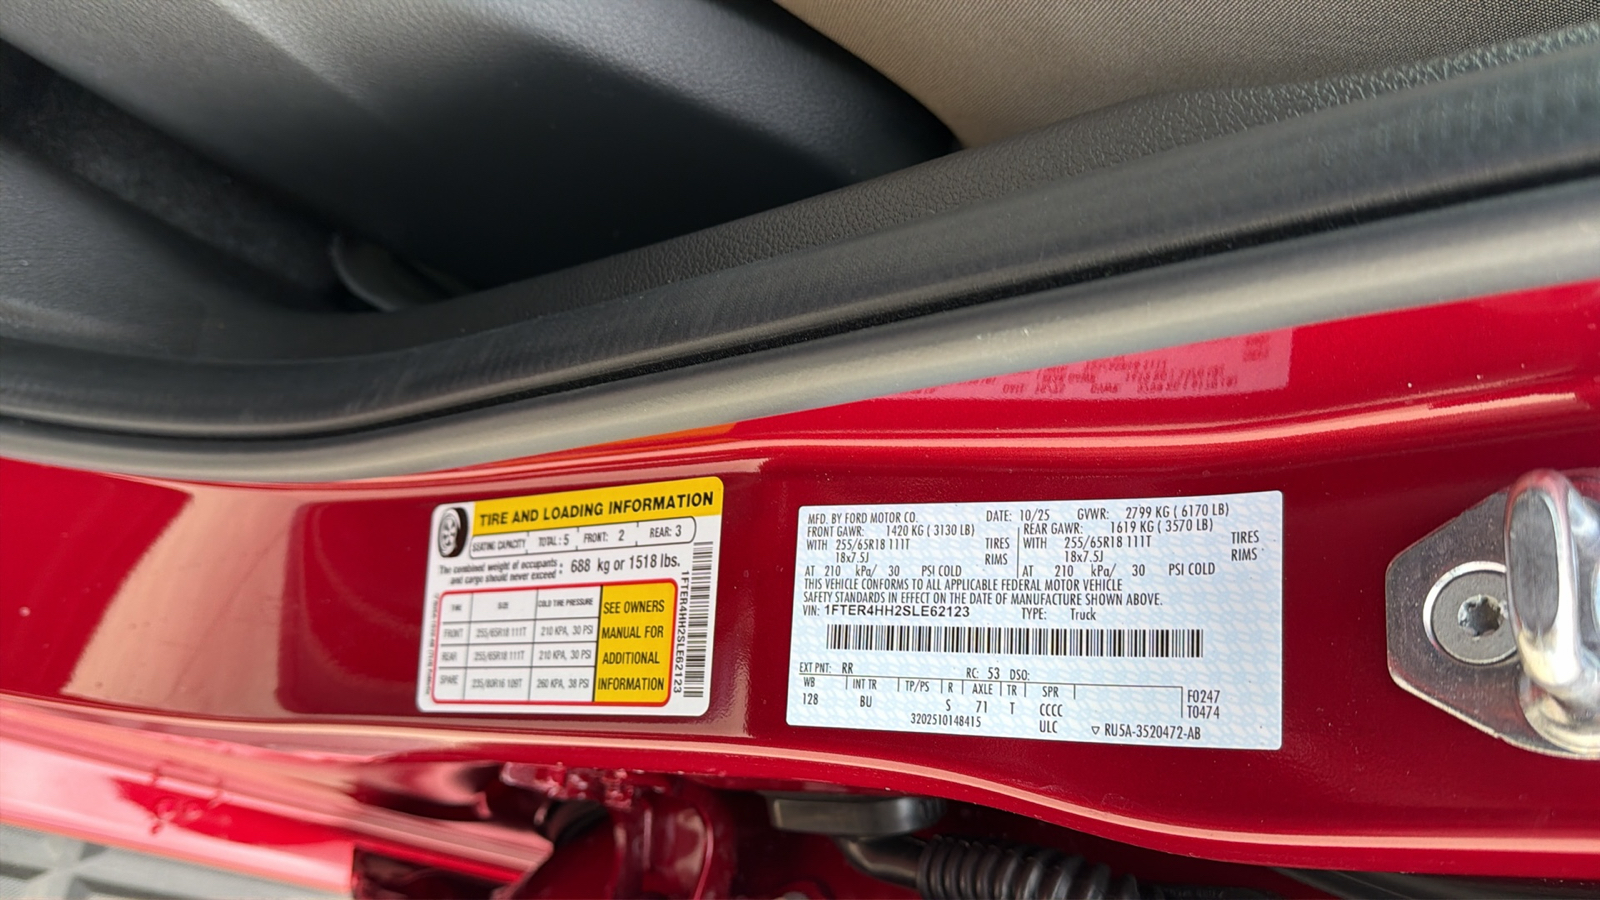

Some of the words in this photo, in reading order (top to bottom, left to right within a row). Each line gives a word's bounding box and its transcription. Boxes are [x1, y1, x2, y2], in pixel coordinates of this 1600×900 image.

[480, 512, 509, 526] TIRE
[512, 509, 538, 524] AND
[544, 502, 603, 520] LOADING
[609, 492, 714, 514] INFORMATION
[986, 510, 1012, 522] DATE:
[1020, 508, 1050, 522] 10/25
[1077, 508, 1109, 520] GVWR:
[1126, 506, 1152, 520] 2799
[1156, 506, 1170, 518] KG
[1182, 504, 1208, 518] 6170
[1212, 502, 1229, 518] LB)
[808, 513, 828, 524] MFD.
[831, 513, 842, 524] BY
[844, 512, 868, 524] FORD
[870, 512, 901, 524] MOTOR
[904, 511, 918, 523] CO.
[650, 526, 672, 538] REAR:
[675, 524, 682, 536] 3
[806, 526, 834, 537] FRONT
[836, 526, 864, 537] GAWR:
[886, 524, 908, 536] 1420
[912, 524, 924, 536] KG
[934, 524, 958, 536] 3130
[960, 524, 975, 537] LB)
[1024, 523, 1048, 534] REAR
[1051, 522, 1083, 534] GAWR:
[1111, 521, 1136, 534] 1619
[1140, 520, 1154, 533] KG
[1166, 519, 1192, 532] 3570
[1196, 518, 1214, 532] LB)
[564, 534, 570, 546] 5
[584, 532, 608, 543] FRONT:
[618, 529, 624, 541] 2
[1231, 530, 1260, 544] TIRES
[472, 542, 496, 552] SEATING
[498, 538, 526, 550] CAPACITY
[806, 539, 828, 550] WITH
[836, 538, 886, 552] 255/65R18
[889, 538, 910, 550] 111T
[985, 538, 1010, 550] TIRES
[1023, 538, 1047, 549] WITH
[1064, 536, 1122, 550] 255/65R18
[1127, 536, 1152, 548] 111T
[836, 552, 869, 564] 18x7.5J
[984, 554, 1008, 565] RIMS
[1065, 551, 1104, 562] 18x7.5J
[1231, 548, 1258, 562] RIMS
[440, 565, 451, 574] The
[453, 562, 485, 573] combined
[488, 562, 510, 573] weight
[512, 560, 520, 570] of
[521, 558, 558, 570] occupants
[571, 558, 590, 572] 688
[597, 558, 610, 574] kg
[614, 559, 625, 570] or
[630, 554, 657, 569] 1518
[660, 553, 680, 568] lbs.
[1022, 566, 1034, 577] AT
[1054, 565, 1074, 577] 210
[1091, 564, 1116, 578] kPa/
[1132, 564, 1146, 576] 30
[1168, 563, 1184, 576] PSI
[1188, 562, 1216, 576] COLD
[804, 565, 815, 576] AT
[824, 565, 841, 576] 210
[855, 564, 878, 578] kPa/
[888, 565, 900, 576] 30
[922, 565, 935, 576] PSI
[938, 565, 962, 576] COLD
[450, 576, 463, 584] and
[464, 574, 482, 586] cargo
[485, 572, 508, 582] should
[510, 572, 529, 582] never
[531, 570, 556, 580] exceed
[804, 578, 822, 590] THIS
[824, 578, 858, 590] VEHICLE
[861, 578, 909, 590] CONFORMS
[912, 578, 923, 590] TO
[926, 578, 942, 590] ALL
[944, 578, 998, 590] APPLICABLE
[1001, 578, 1042, 591] FEDERAL
[1044, 578, 1080, 591] MOTOR
[1082, 578, 1122, 591] VEHICLE
[566, 598, 593, 606] PRESSURE
[803, 592, 832, 603] SAFETY
[834, 592, 886, 604] STANDARDS
[888, 592, 898, 604] IN
[901, 592, 930, 604] EFFECT
[933, 592, 946, 604] ON
[950, 592, 966, 604] THE
[970, 592, 992, 605] DATE
[996, 592, 1008, 605] OF
[1010, 592, 1082, 606] MANUFACTURE
[1086, 593, 1122, 606] SHOWN
[1126, 593, 1163, 606] ABOVE.
[604, 602, 620, 614] SEE
[624, 600, 665, 614] OWNERS
[802, 604, 820, 616] VIN:
[824, 604, 970, 617] 1FTER4HH2SLE62123
[1022, 608, 1046, 620] TYPE:
[1070, 607, 1096, 620] Truck
[541, 626, 554, 636] 210
[572, 625, 582, 635] 30
[583, 625, 593, 634] PSI
[602, 626, 641, 638] MANUAL
[644, 626, 664, 638] FOR
[673, 571, 690, 694] 1FTER4HH2SLE62123
[538, 650, 552, 660] 210
[570, 650, 580, 660] 30
[581, 650, 592, 659] PSI
[602, 652, 660, 664] ADDITIONAL
[799, 662, 814, 672] EXT
[814, 662, 832, 674] PNT:
[842, 662, 854, 674] RR
[966, 668, 979, 679] RC:
[988, 668, 1000, 680] 53
[1010, 669, 1030, 680] DSO:
[578, 678, 589, 688] PSI
[598, 678, 664, 690] INFORMATION
[803, 677, 815, 688] WB
[852, 678, 866, 689] INT
[868, 678, 877, 690] TR
[905, 680, 930, 692] TP/PS
[948, 682, 954, 692] R
[972, 683, 992, 694] AXLE
[1007, 684, 1017, 696] TR
[1042, 686, 1059, 698] SPR
[802, 693, 818, 705] 128
[860, 696, 872, 708] BU
[1188, 690, 1220, 704] F0247
[946, 700, 951, 711] S
[976, 700, 988, 712] 71
[1010, 702, 1014, 714] T
[1040, 704, 1062, 717] CCCC
[1188, 705, 1220, 719] T0474
[910, 713, 981, 727] 3202510148415
[1039, 720, 1058, 733] ULC
[1104, 724, 1201, 740] RU5A-3520472-AB
